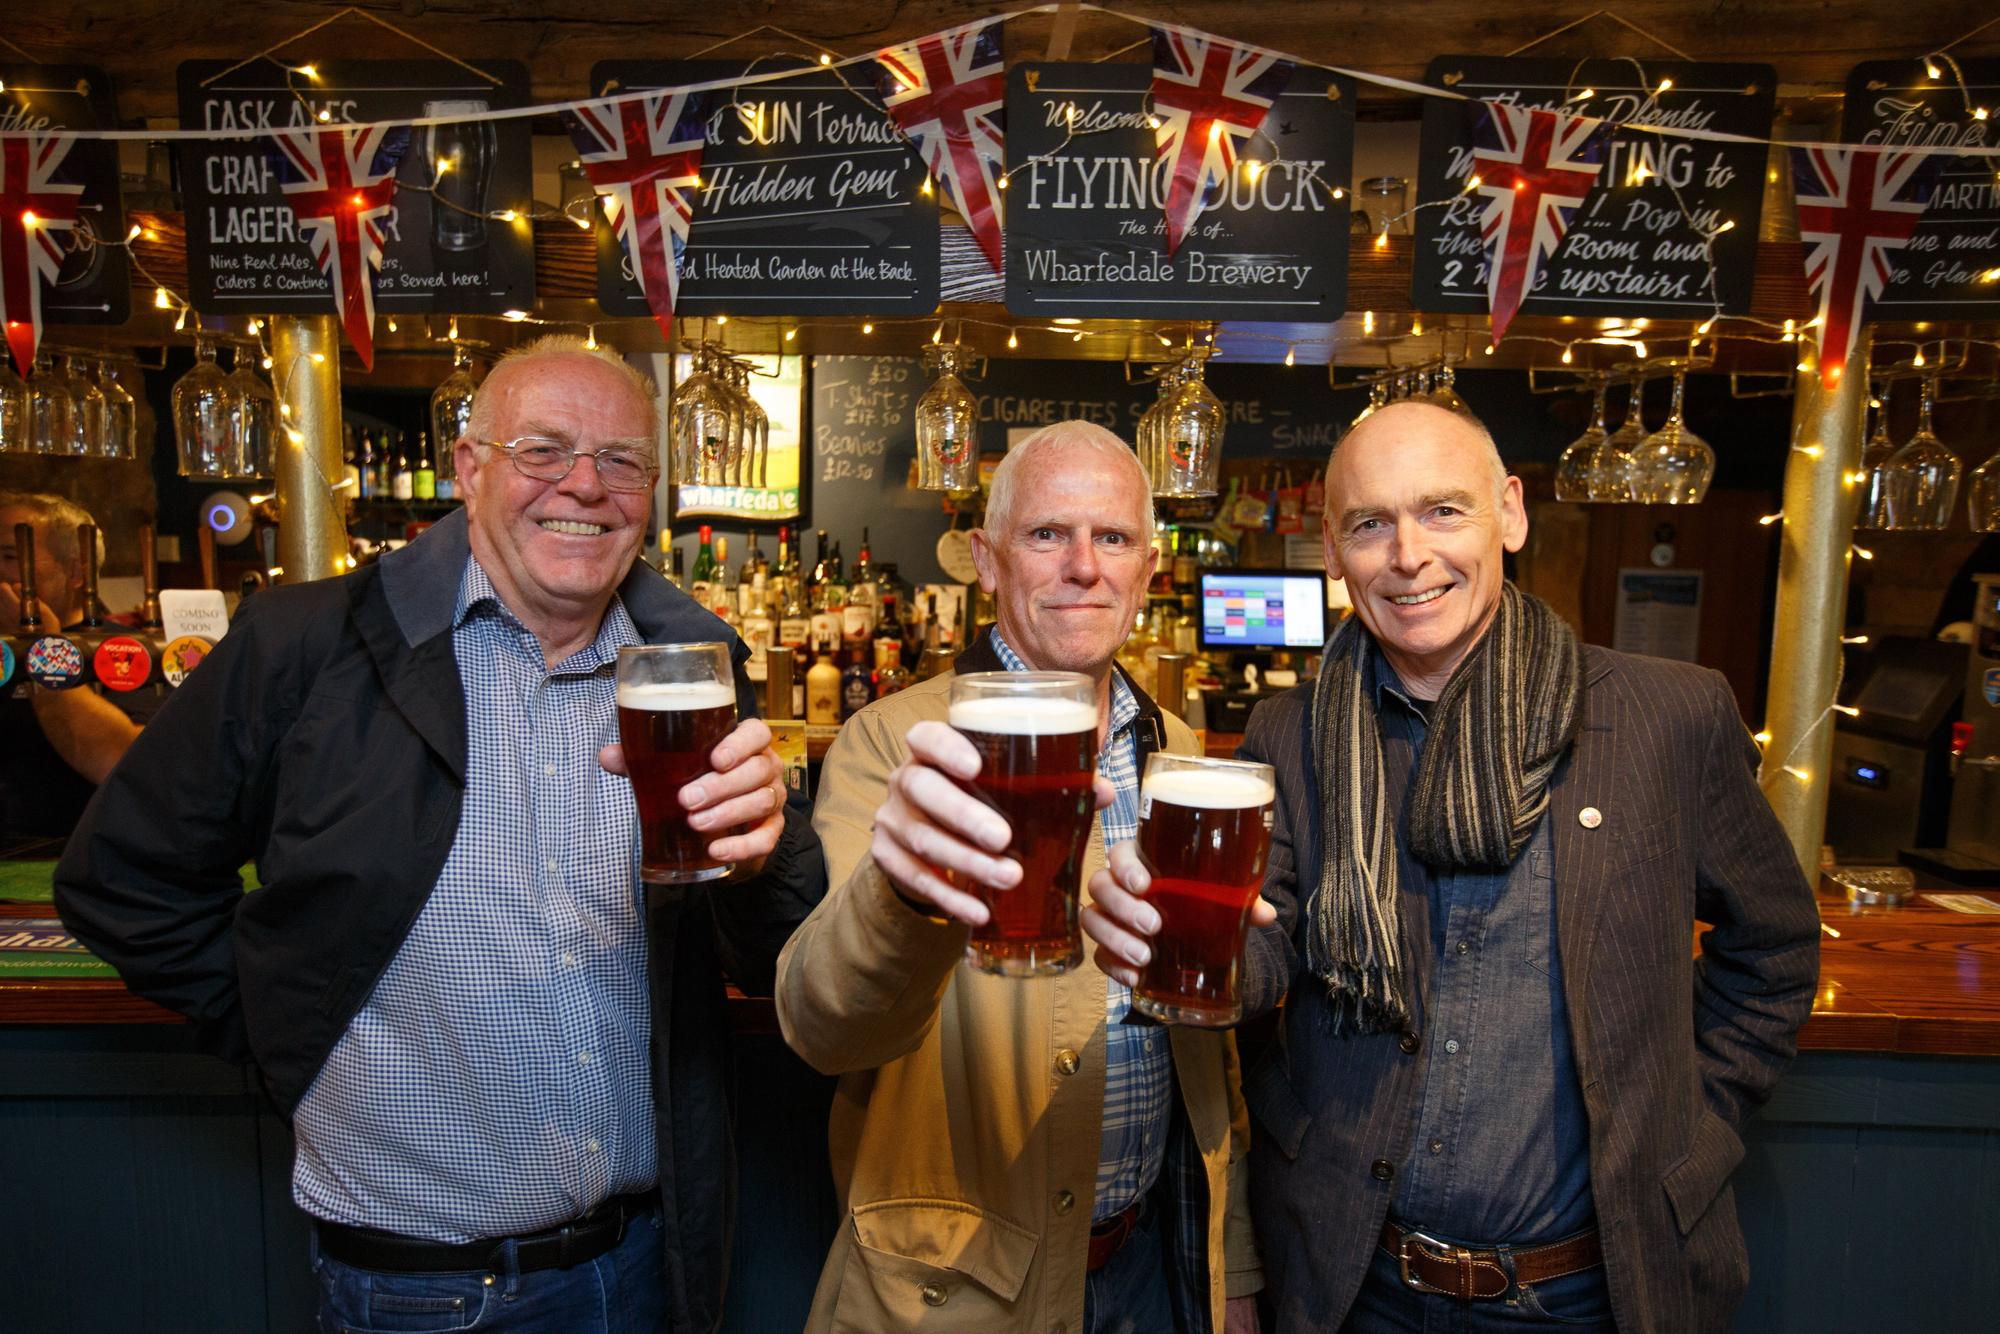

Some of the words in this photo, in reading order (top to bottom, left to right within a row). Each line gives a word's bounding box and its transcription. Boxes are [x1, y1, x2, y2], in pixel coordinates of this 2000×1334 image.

[205, 100, 275, 141] CASK
[737, 101, 802, 145] SUN
[1704, 152, 1736, 189] to
[701, 165, 817, 215] Hidden
[208, 206, 296, 244] LAGER
[1119, 219, 1148, 236] The
[1621, 199, 1681, 236] Pop
[1432, 231, 1483, 255] the
[1563, 233, 1640, 261] Room
[1653, 240, 1713, 262] and
[1948, 227, 1999, 250] and
[210, 254, 240, 270] Nine
[243, 254, 277, 270] Real
[280, 254, 314, 270] Ales,
[705, 252, 764, 280] Heated
[768, 255, 826, 281] Garden
[830, 257, 848, 280] at
[851, 257, 875, 280] the
[1025, 250, 1174, 283] Wharfedale
[1187, 251, 1312, 289] Brewery
[1441, 260, 1463, 287] 2
[216, 275, 257, 289] Ciders
[263, 275, 272, 287] &
[401, 272, 447, 288] Served
[869, 364, 908, 386] £30
[978, 395, 1118, 428] CIGARETTES
[815, 424, 887, 457] Beanies
[823, 457, 874, 481] £12.50
[172, 609, 220, 620] COMING
[180, 622, 212, 633] SOON
[104, 644, 142, 654] VOCATION
